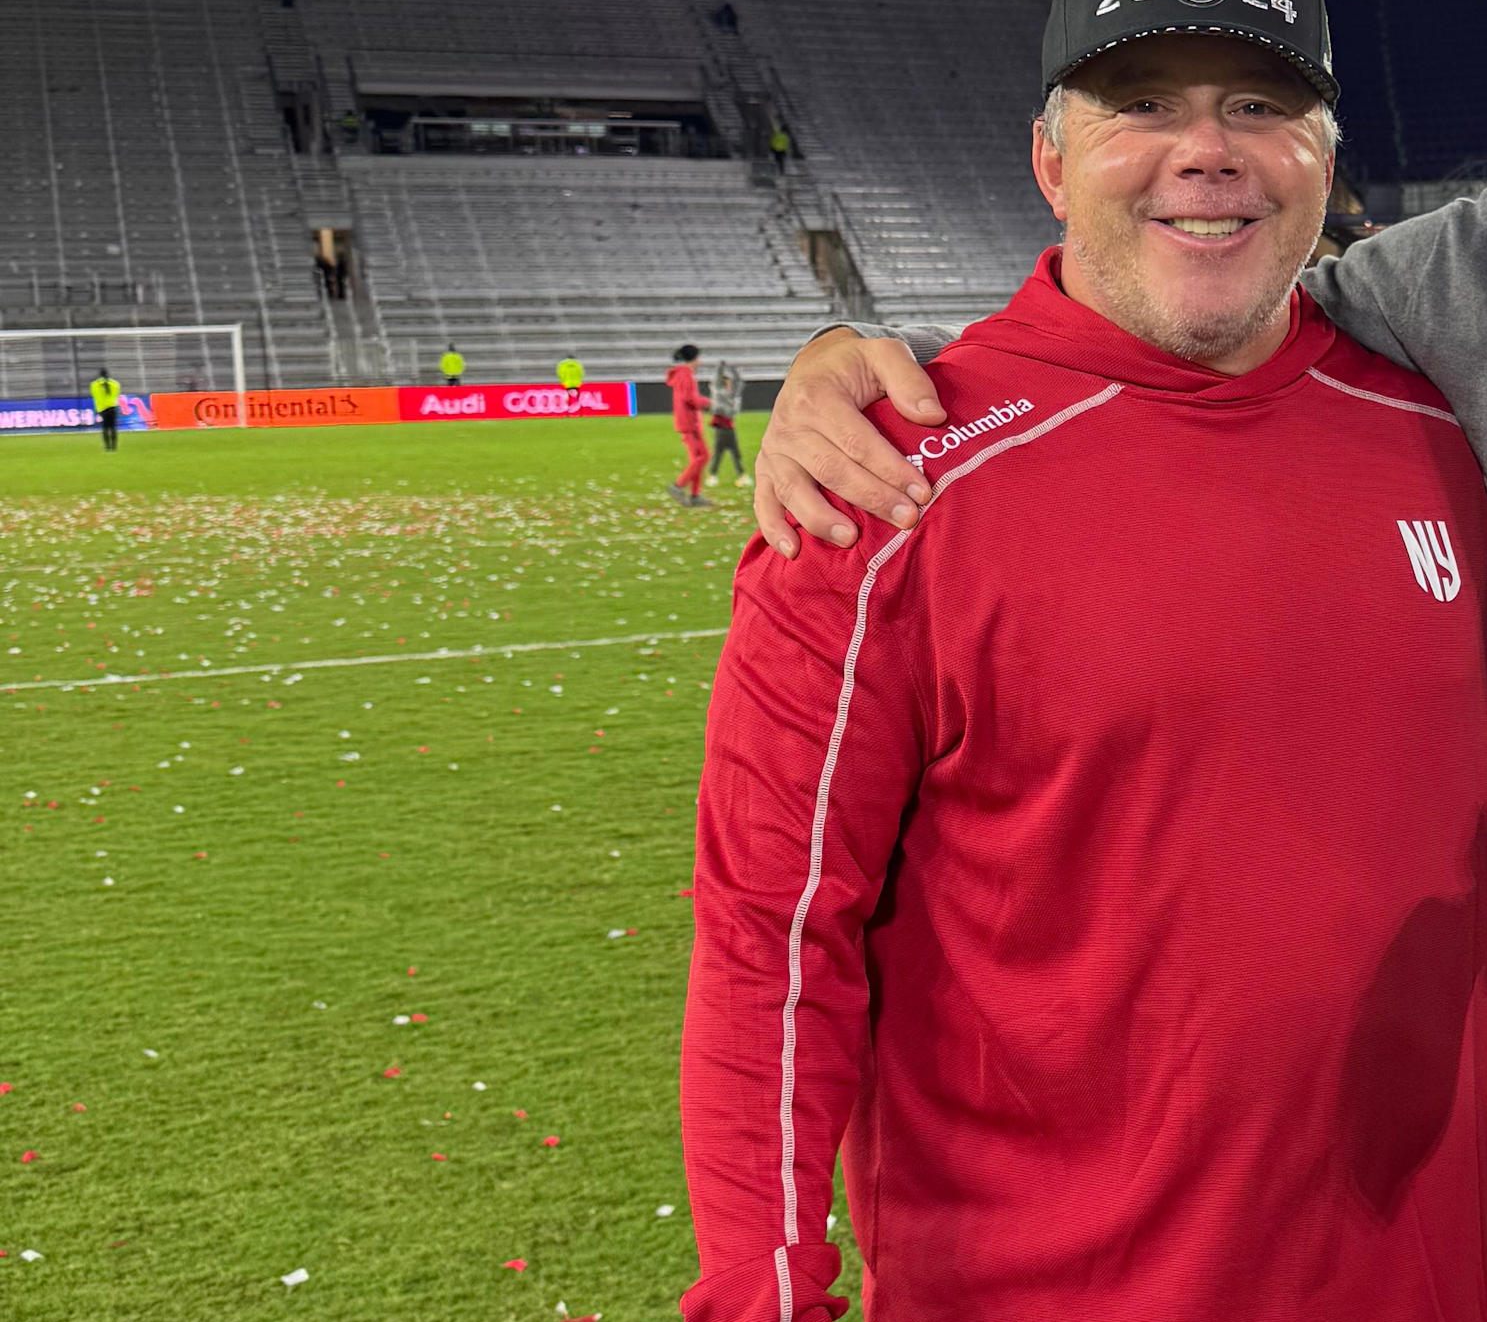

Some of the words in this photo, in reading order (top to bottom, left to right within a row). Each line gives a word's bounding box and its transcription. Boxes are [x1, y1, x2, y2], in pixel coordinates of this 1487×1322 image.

[194, 395, 337, 426] Coninental
[419, 393, 486, 415] Audi
[918, 397, 1035, 459] Columbia
